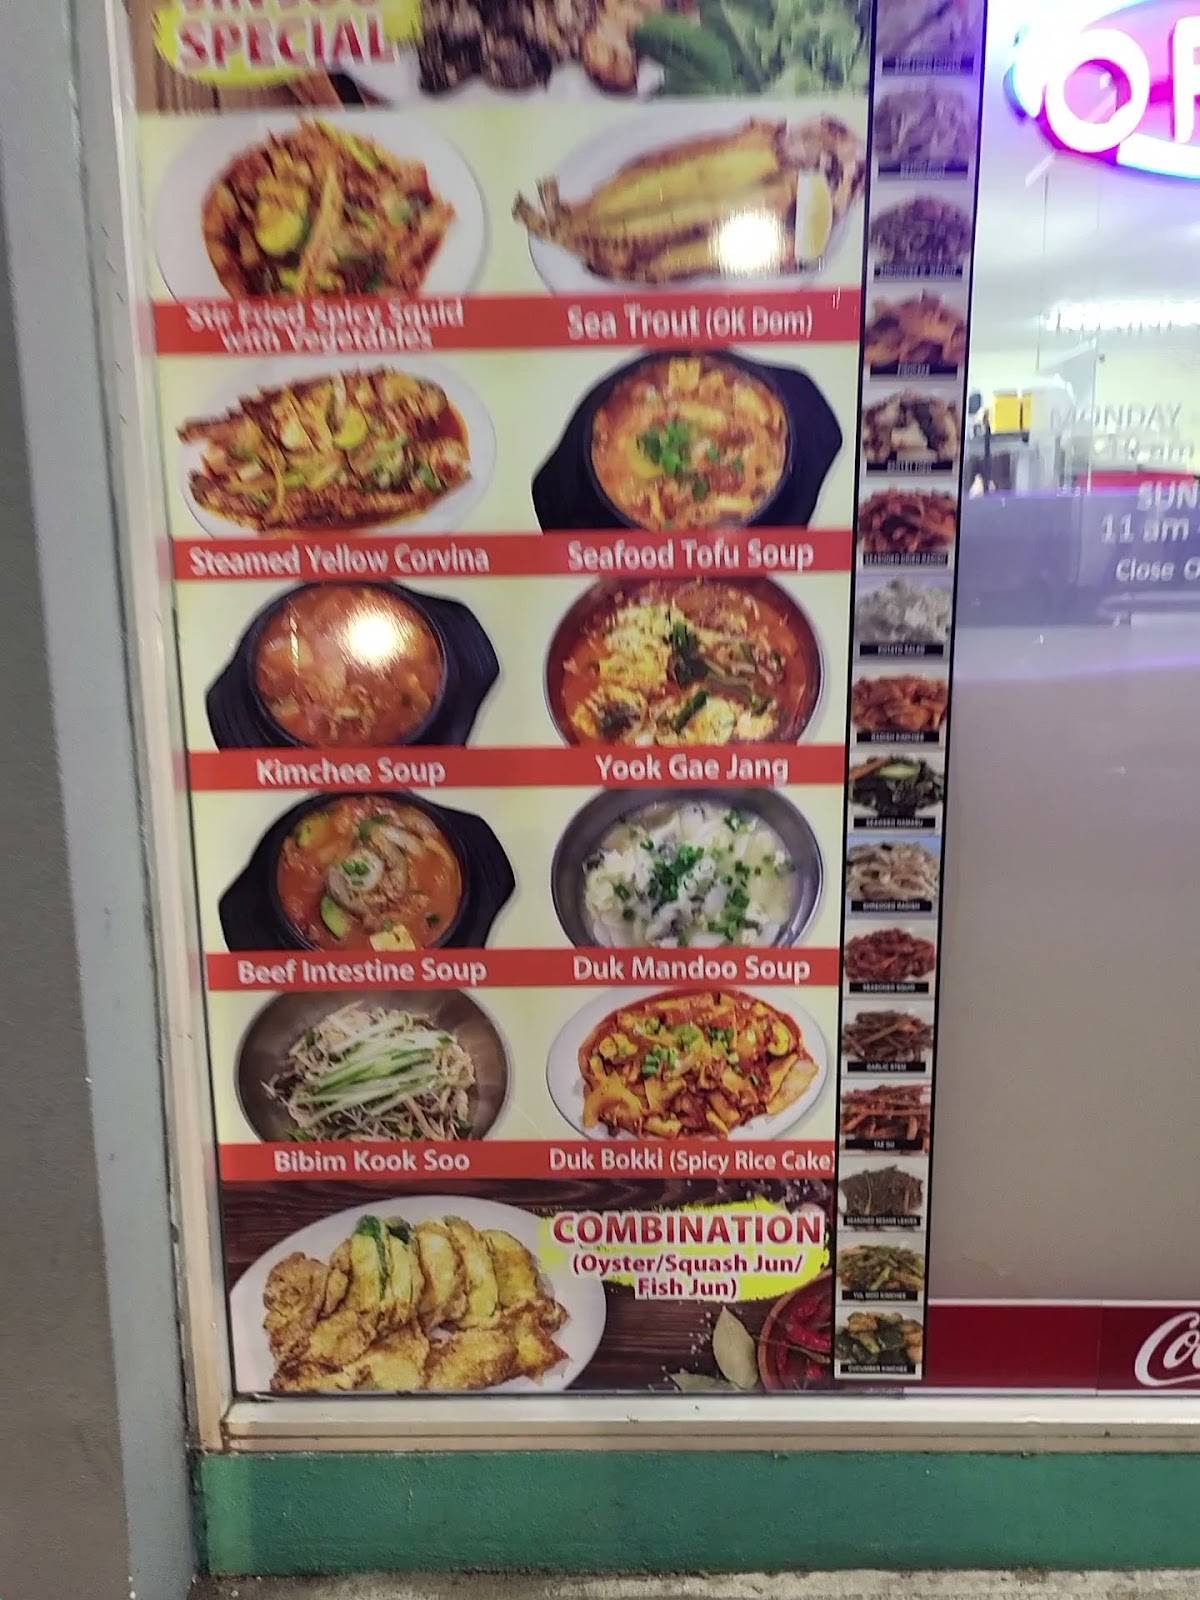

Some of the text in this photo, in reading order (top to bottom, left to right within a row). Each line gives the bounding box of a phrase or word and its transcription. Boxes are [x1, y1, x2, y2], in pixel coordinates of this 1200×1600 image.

[179, 15, 398, 68] SPECIAL
[312, 300, 381, 334] Spicy
[387, 298, 464, 333] Squid
[567, 303, 812, 340] Sea Trout (OK Dom)
[286, 322, 434, 354] Vegetables
[1101, 513, 1190, 543] 11 am
[190, 543, 490, 576] Steamed Yellow Corvina
[568, 537, 814, 573] Seafood Tofu Soup
[1115, 557, 1175, 582] Close
[256, 757, 446, 788] Kimchee Soup
[595, 753, 788, 788] Yook Gae Jang
[237, 957, 487, 986] Beef Intestine Soup
[573, 955, 811, 985] Duk Mandoo Soup
[274, 1149, 470, 1172] Bibim Kook Soo
[550, 1148, 595, 1171] Duk
[602, 1148, 663, 1171] Bokki
[669, 1148, 729, 1174] (Spicy
[735, 1149, 776, 1171] Rice
[553, 1214, 823, 1245] COMBINATION
[573, 1253, 803, 1275] (Oyster/Squash Jun/
[638, 1278, 738, 1299] Fish Jun)
